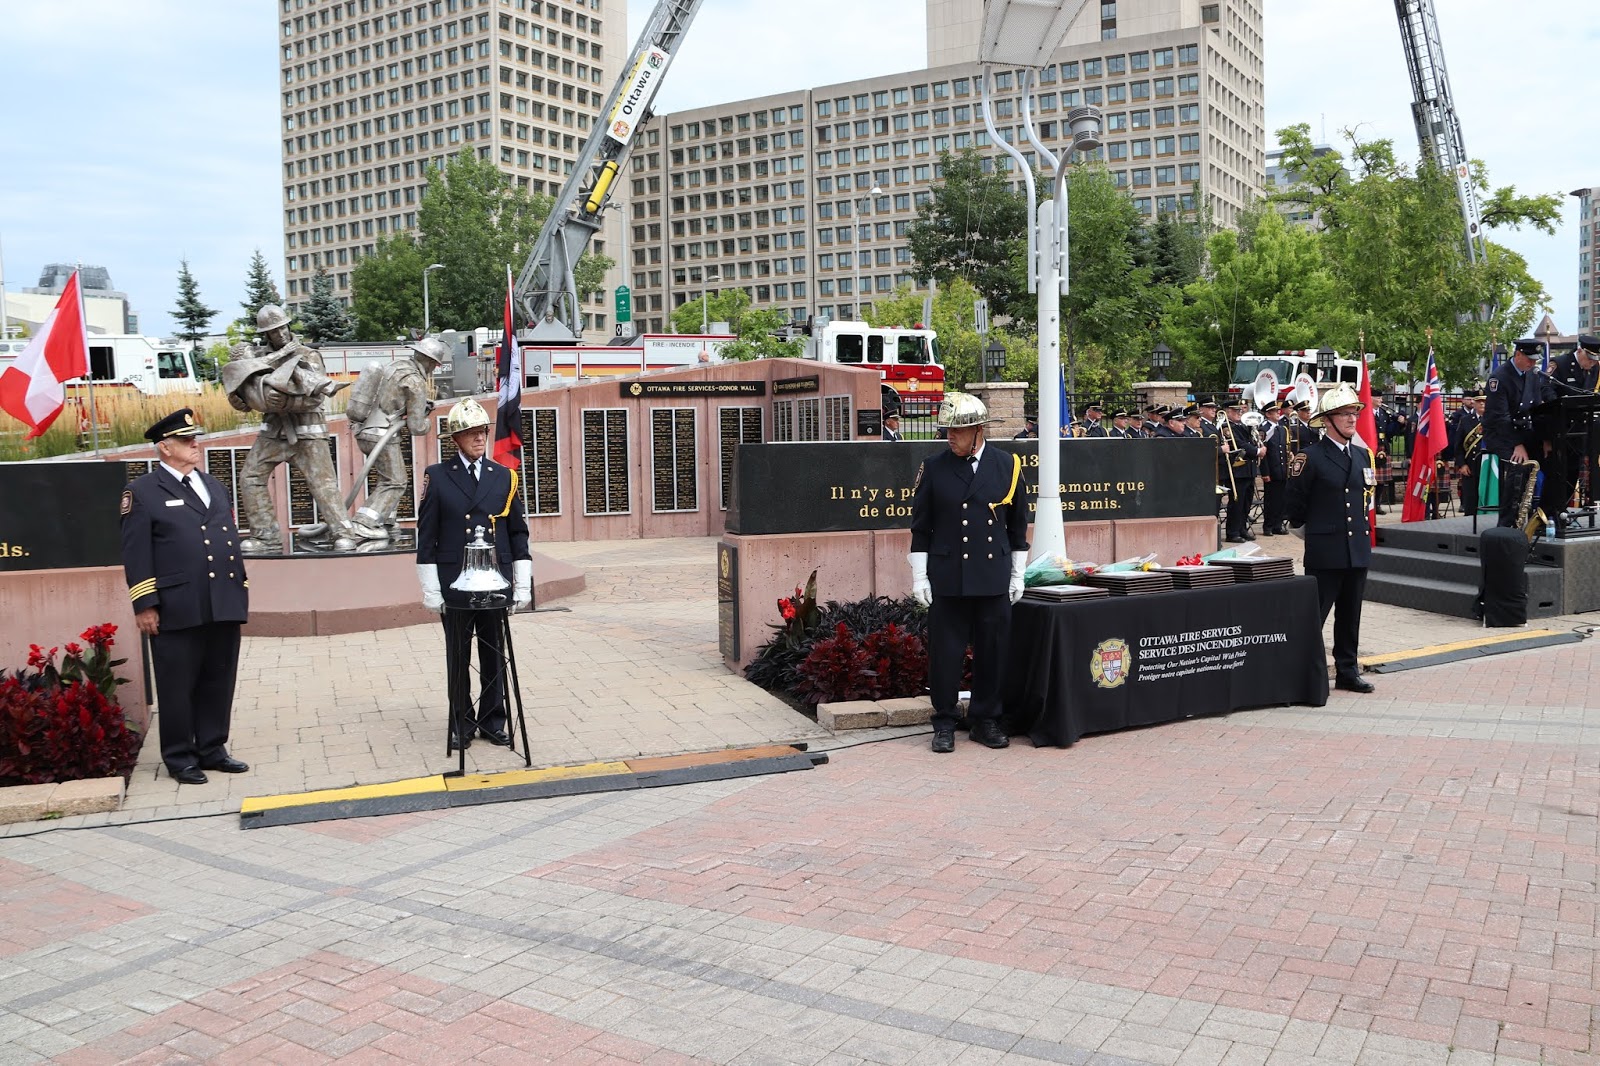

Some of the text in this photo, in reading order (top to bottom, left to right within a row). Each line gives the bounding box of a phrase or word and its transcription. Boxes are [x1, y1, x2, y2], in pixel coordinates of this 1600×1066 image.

[622, 70, 651, 115] Ottawa
[1463, 181, 1474, 218] Ottawa
[129, 374, 142, 382] P52
[831, 486, 845, 499] Il
[850, 485, 879, 501] n'y
[885, 488, 895, 498] a
[1059, 481, 1145, 494] amour que
[859, 504, 879, 517] de
[1080, 498, 1121, 510] amis.
[1139, 625, 1242, 647] OTTAWA FIRE SERVICES
[1138, 633, 1287, 660] SERVICE DES INCENDIES D'OTTAWA
[1138, 663, 1166, 672] Protecting
[1178, 657, 1200, 667] Nation's
[1200, 653, 1221, 663] Capital
[1234, 650, 1247, 658] Pride
[1175, 667, 1196, 677] capitale
[1196, 663, 1222, 674] nationale
